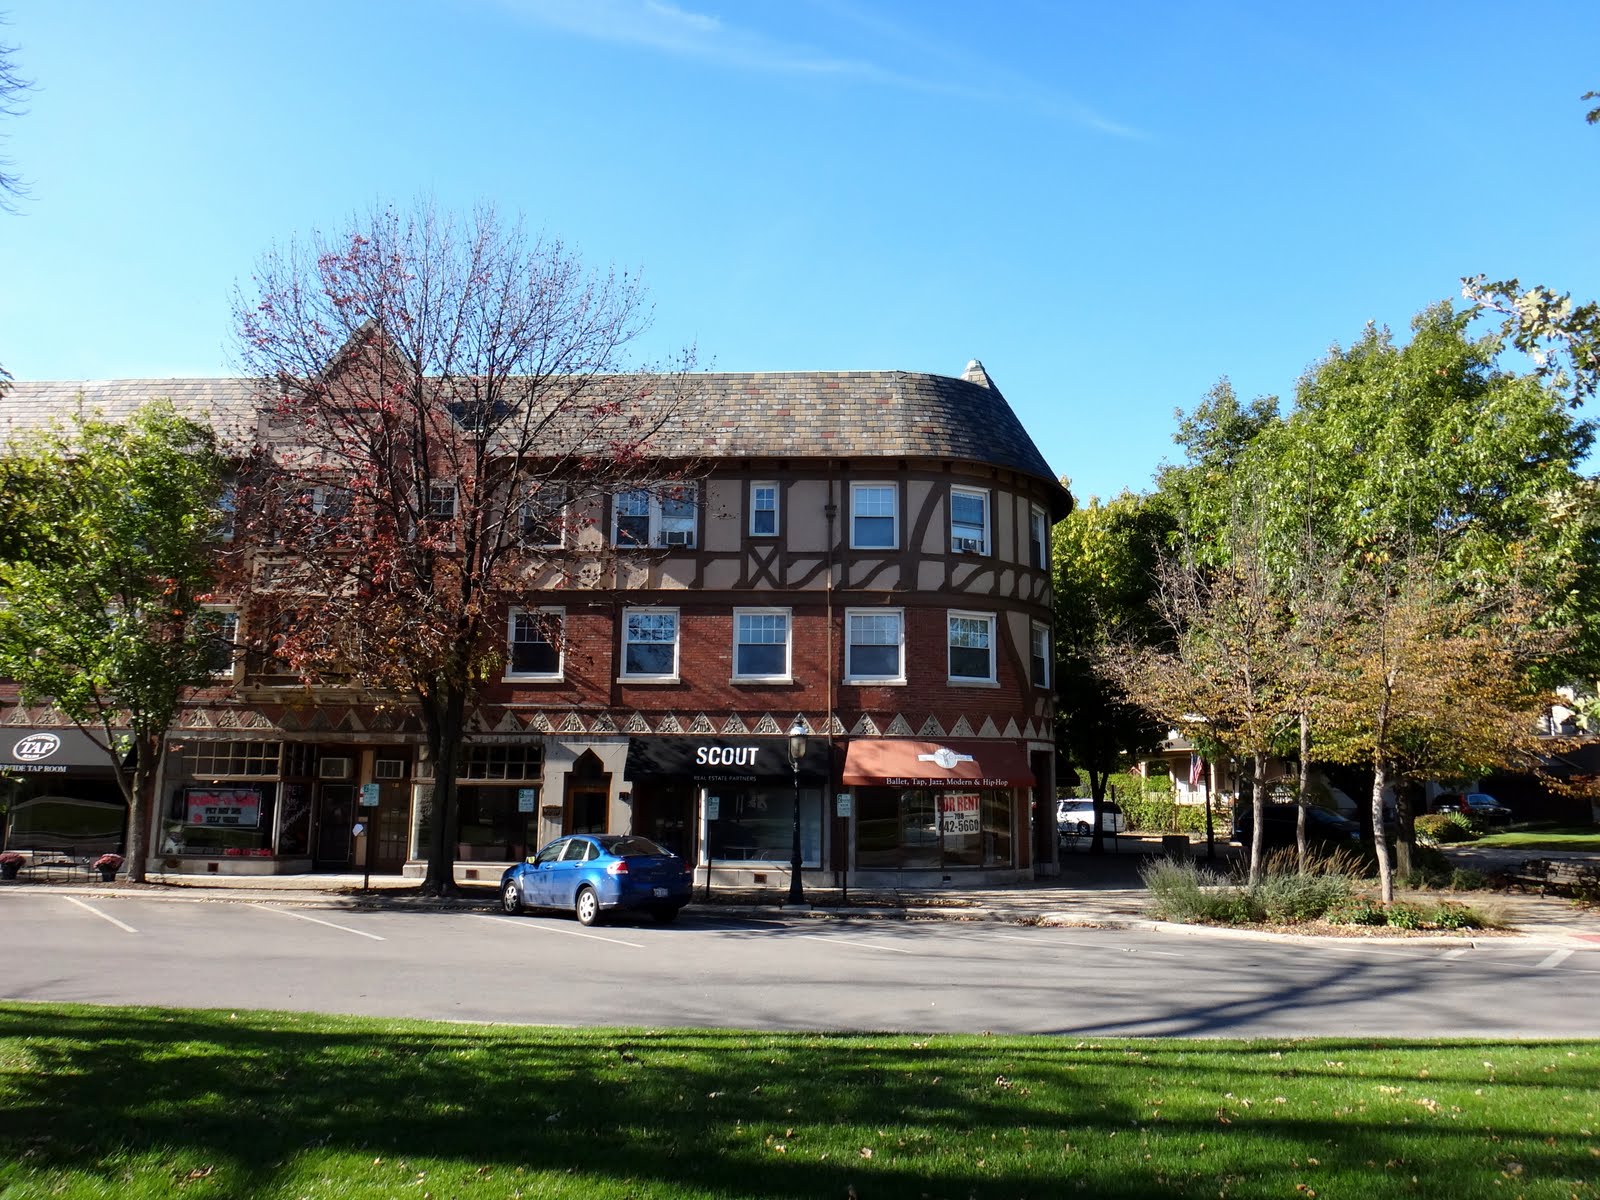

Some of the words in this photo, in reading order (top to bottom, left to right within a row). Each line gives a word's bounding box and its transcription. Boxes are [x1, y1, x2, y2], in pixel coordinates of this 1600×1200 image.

[20, 742, 54, 754] TAP
[696, 746, 760, 766] SCOUT
[886, 777, 910, 786] Ballet,
[912, 779, 927, 787] Tap,
[982, 779, 1009, 788] Hip-Hop
[957, 795, 980, 812] RENT
